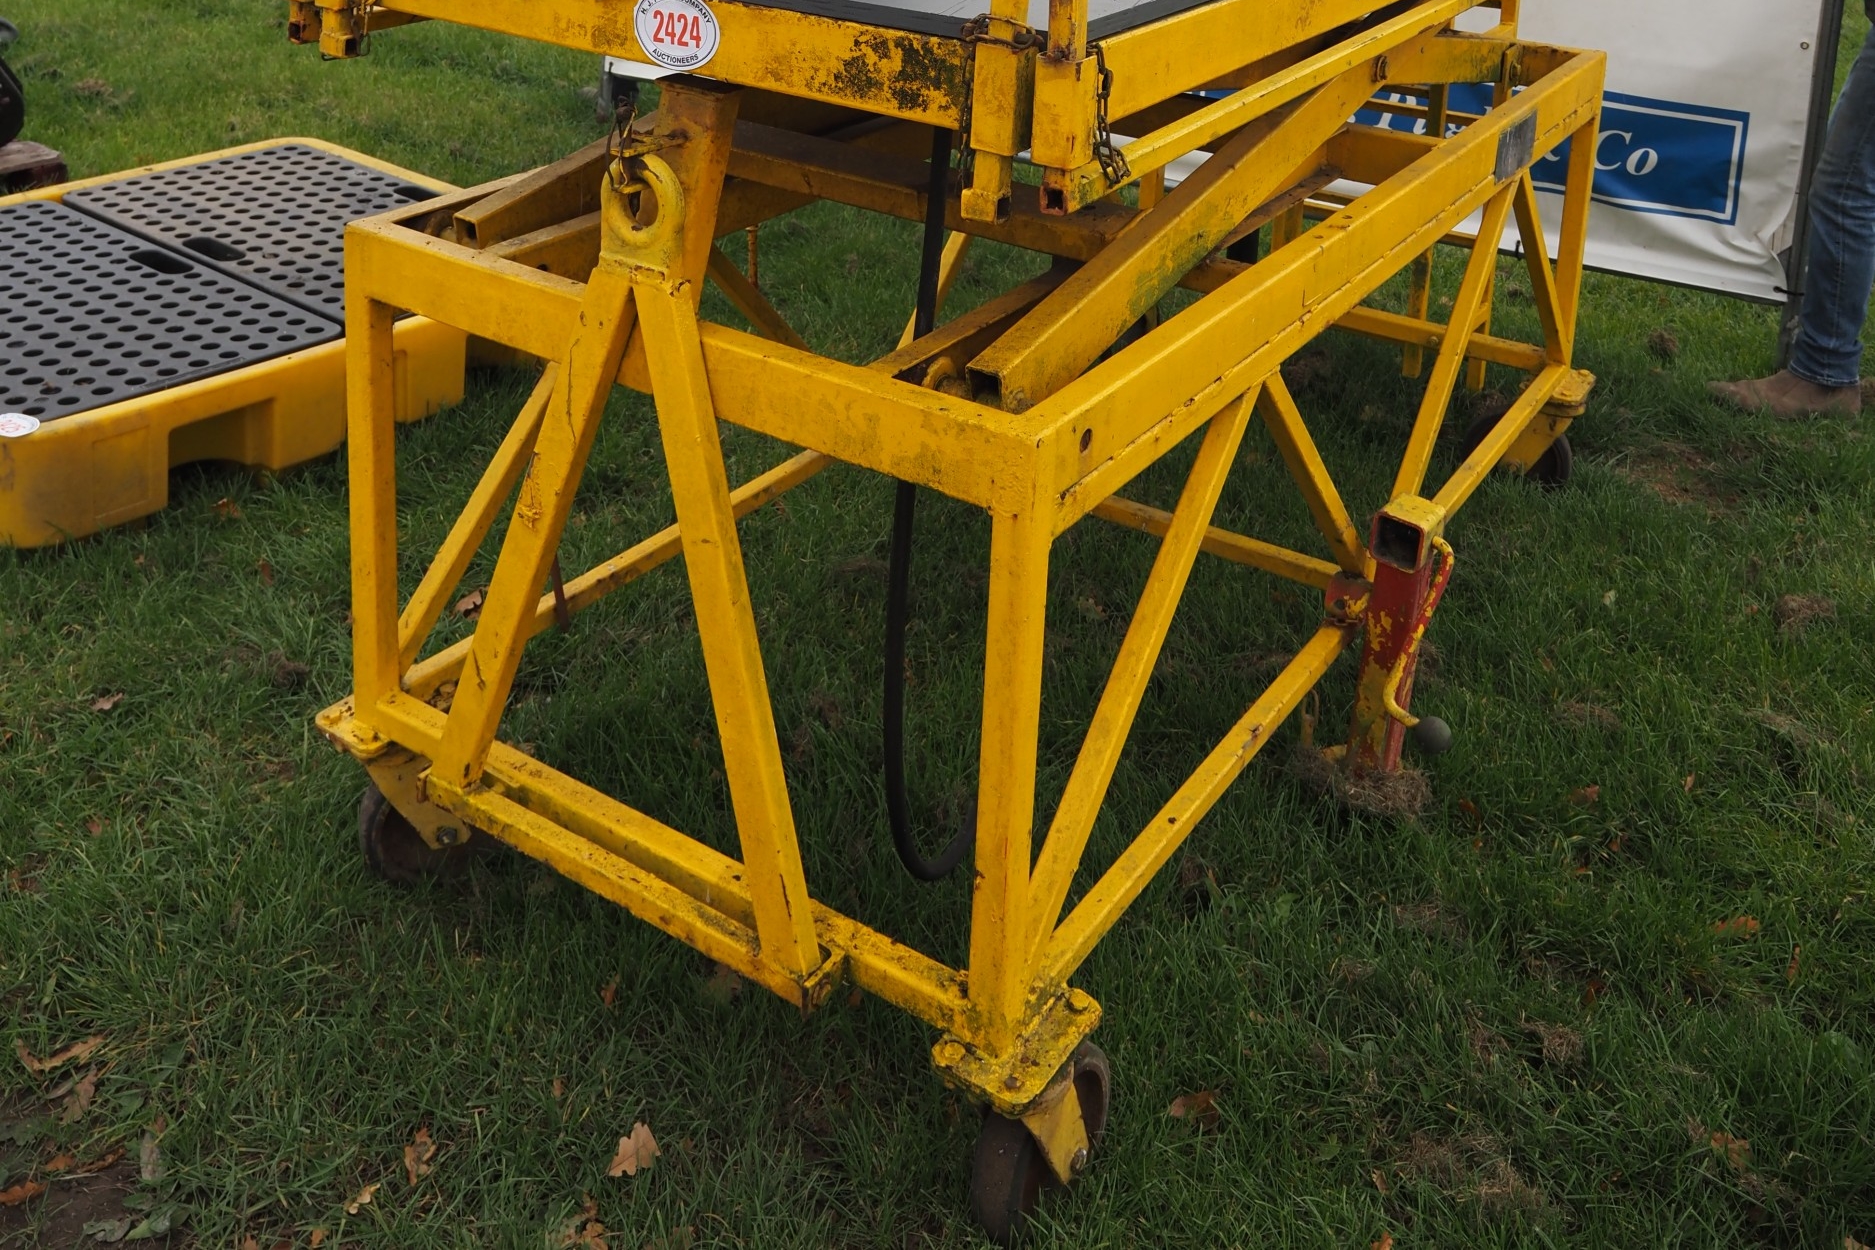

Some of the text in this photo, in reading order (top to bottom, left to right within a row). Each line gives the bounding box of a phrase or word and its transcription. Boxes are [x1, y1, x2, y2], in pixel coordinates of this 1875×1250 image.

[652, 9, 702, 49] 2424
[652, 48, 699, 64] AUCTIONEERS
[1594, 129, 1659, 176] Co
